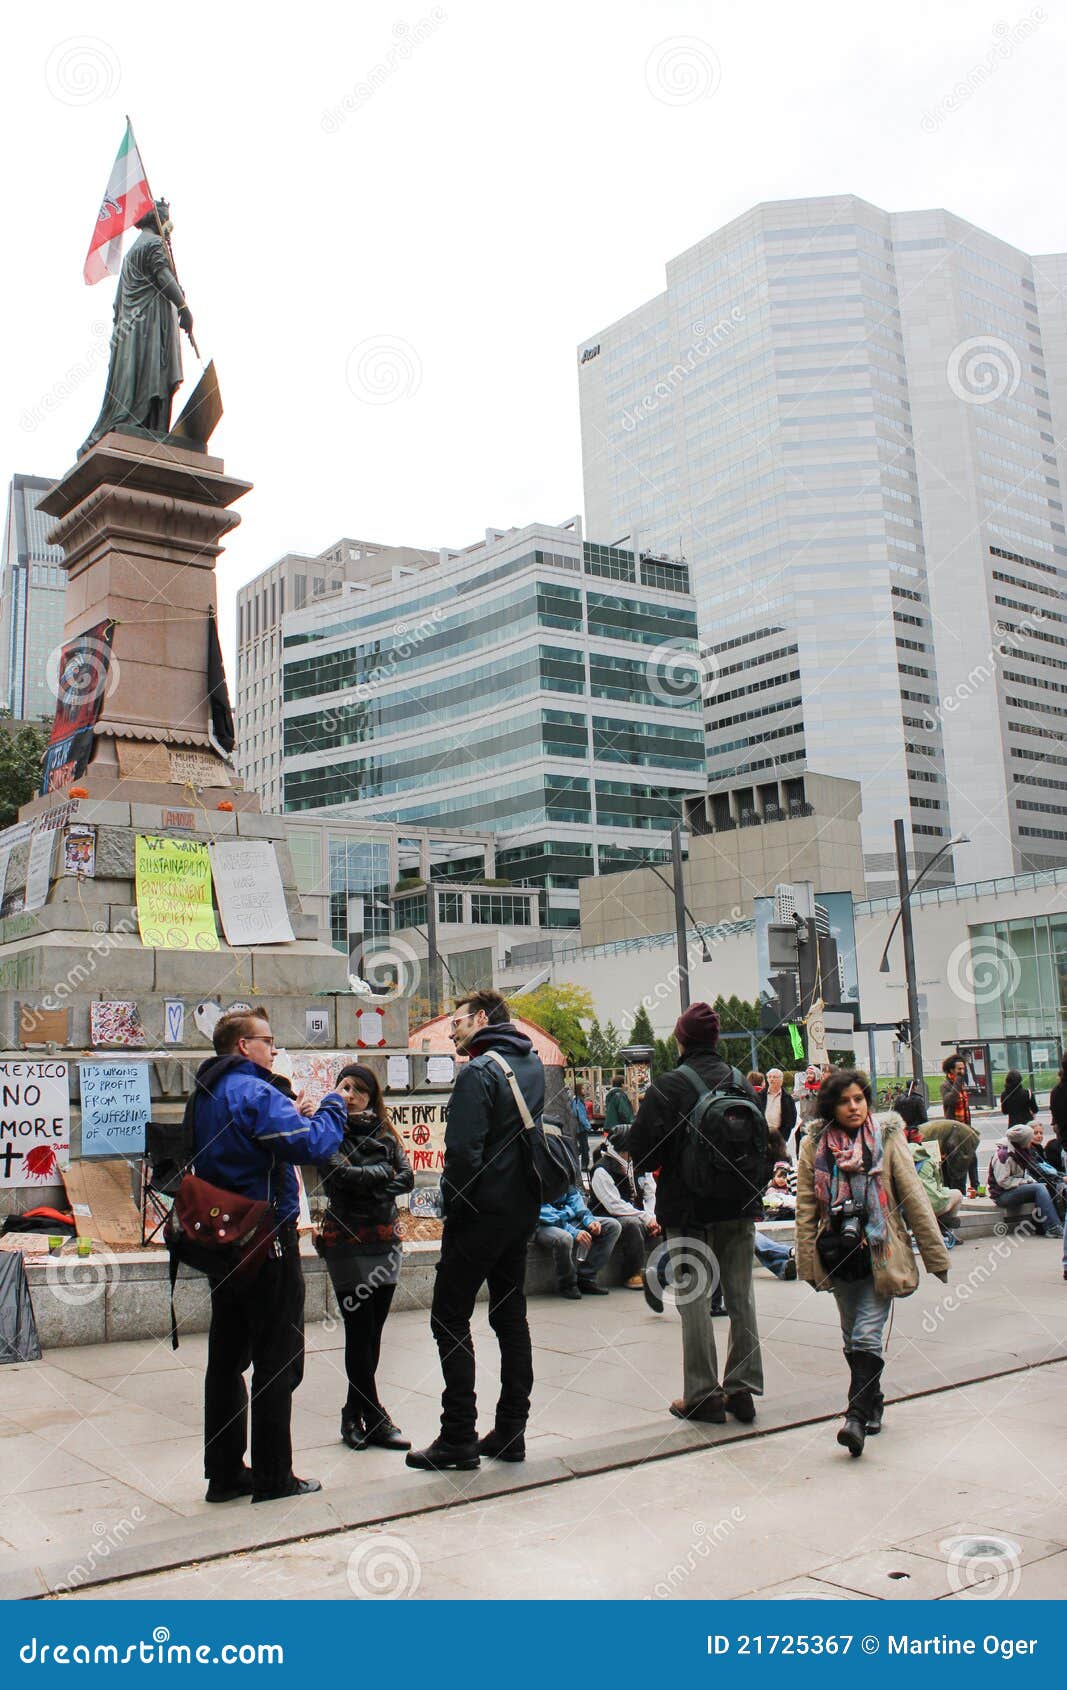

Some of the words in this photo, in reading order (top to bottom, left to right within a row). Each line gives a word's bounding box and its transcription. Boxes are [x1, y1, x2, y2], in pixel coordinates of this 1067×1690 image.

[145, 838, 165, 851] WE
[141, 879, 207, 901] ENVIRONMENT
[149, 896, 199, 914] ECONOMY
[153, 912, 194, 926] SOCIETY
[0, 1064, 67, 1079] MEXICO
[83, 1066, 100, 1078] IT'S
[103, 1067, 138, 1077] WRONG
[82, 1080, 95, 1091] TO
[100, 1079, 136, 1091] PROFIT
[3, 1084, 41, 1107] NO
[84, 1095, 117, 1108] FROM
[122, 1094, 141, 1104] THE
[92, 1110, 147, 1125] SUFFERING
[411, 1106, 437, 1125] PART
[0, 1117, 64, 1139] MORE
[86, 1127, 99, 1139] OF
